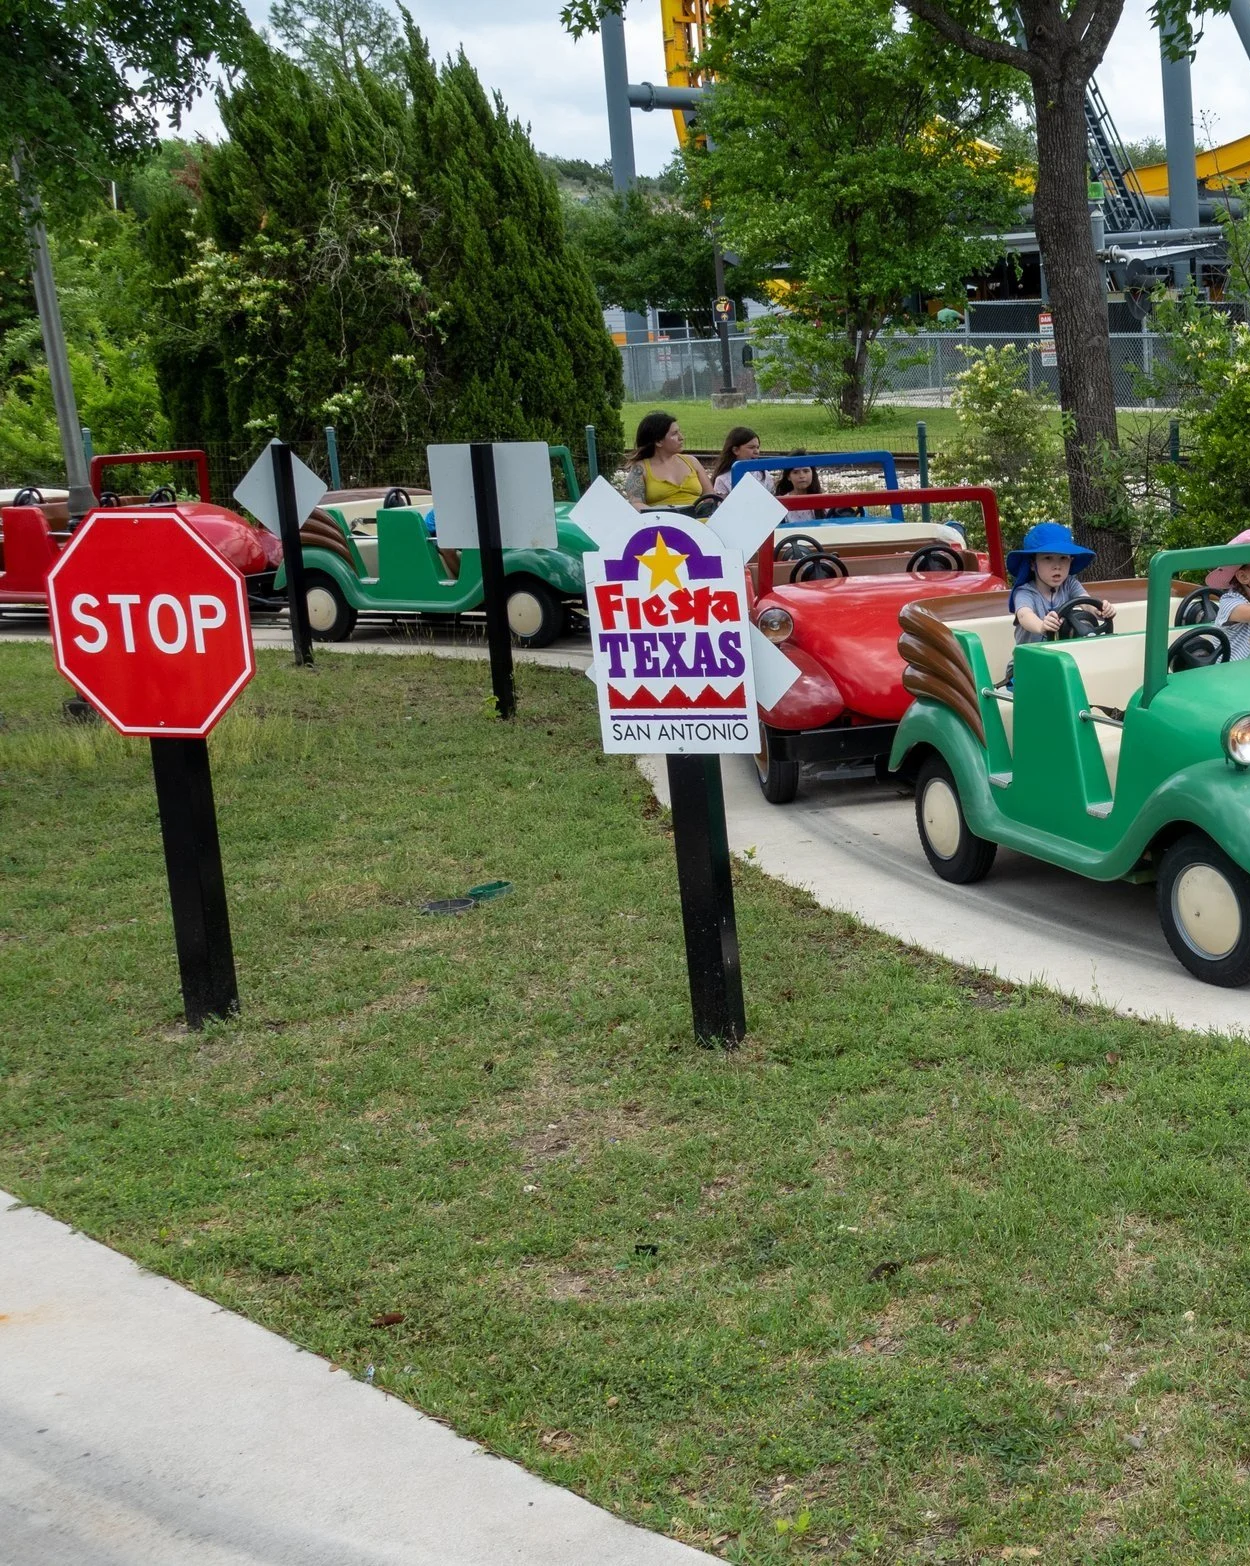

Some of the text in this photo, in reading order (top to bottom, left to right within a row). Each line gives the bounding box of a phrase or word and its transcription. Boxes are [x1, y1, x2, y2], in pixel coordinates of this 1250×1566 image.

[71, 593, 227, 654] STOP
[594, 583, 741, 631] Fiesta
[598, 631, 746, 678] TEXAS
[612, 723, 749, 741] SAN ANTONIO
